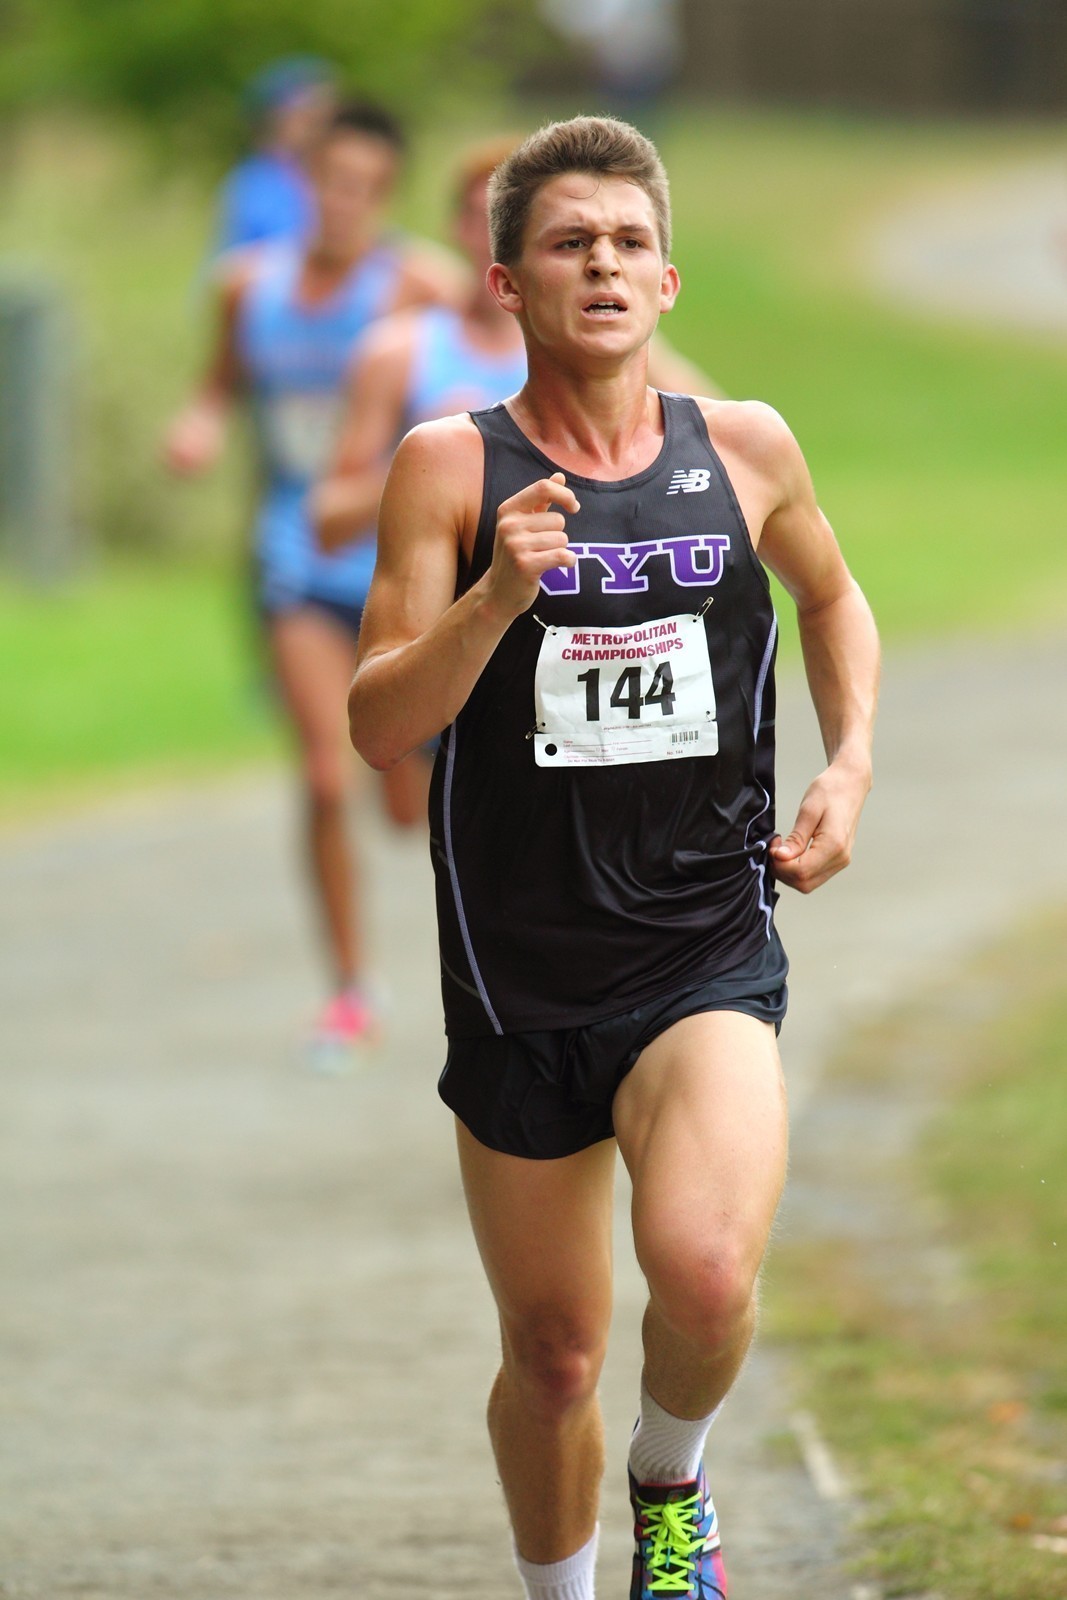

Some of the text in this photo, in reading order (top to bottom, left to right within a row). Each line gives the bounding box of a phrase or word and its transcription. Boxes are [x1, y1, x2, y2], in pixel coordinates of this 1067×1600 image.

[571, 622, 677, 645] METROPOLITAN
[561, 638, 684, 661] CHAMPIONSHIPS
[577, 661, 676, 721] 144
